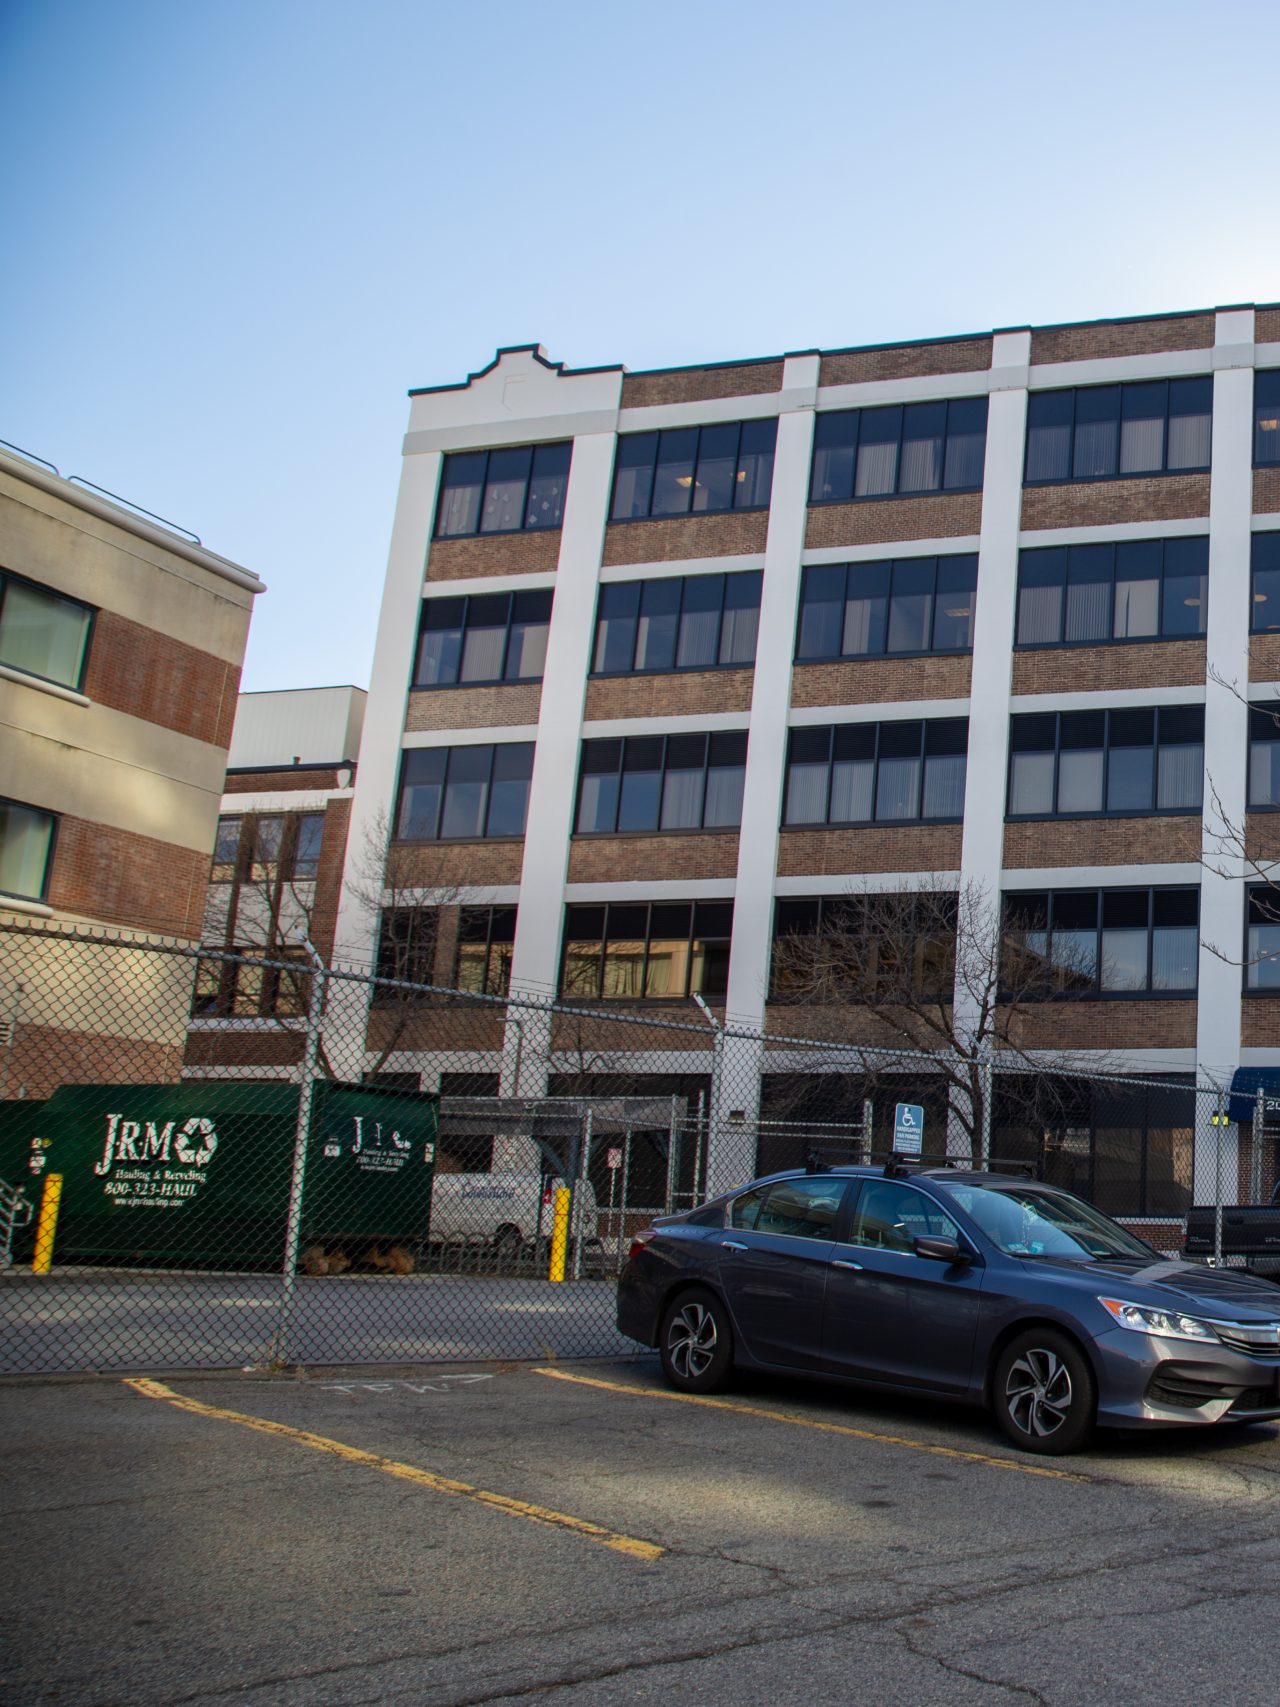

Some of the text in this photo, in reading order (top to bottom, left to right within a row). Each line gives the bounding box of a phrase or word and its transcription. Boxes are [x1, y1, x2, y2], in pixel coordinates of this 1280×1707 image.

[153, 1170, 161, 1180] &
[164, 1170, 207, 1183] Recycling
[104, 1182, 197, 1196] 800-323-HAUL
